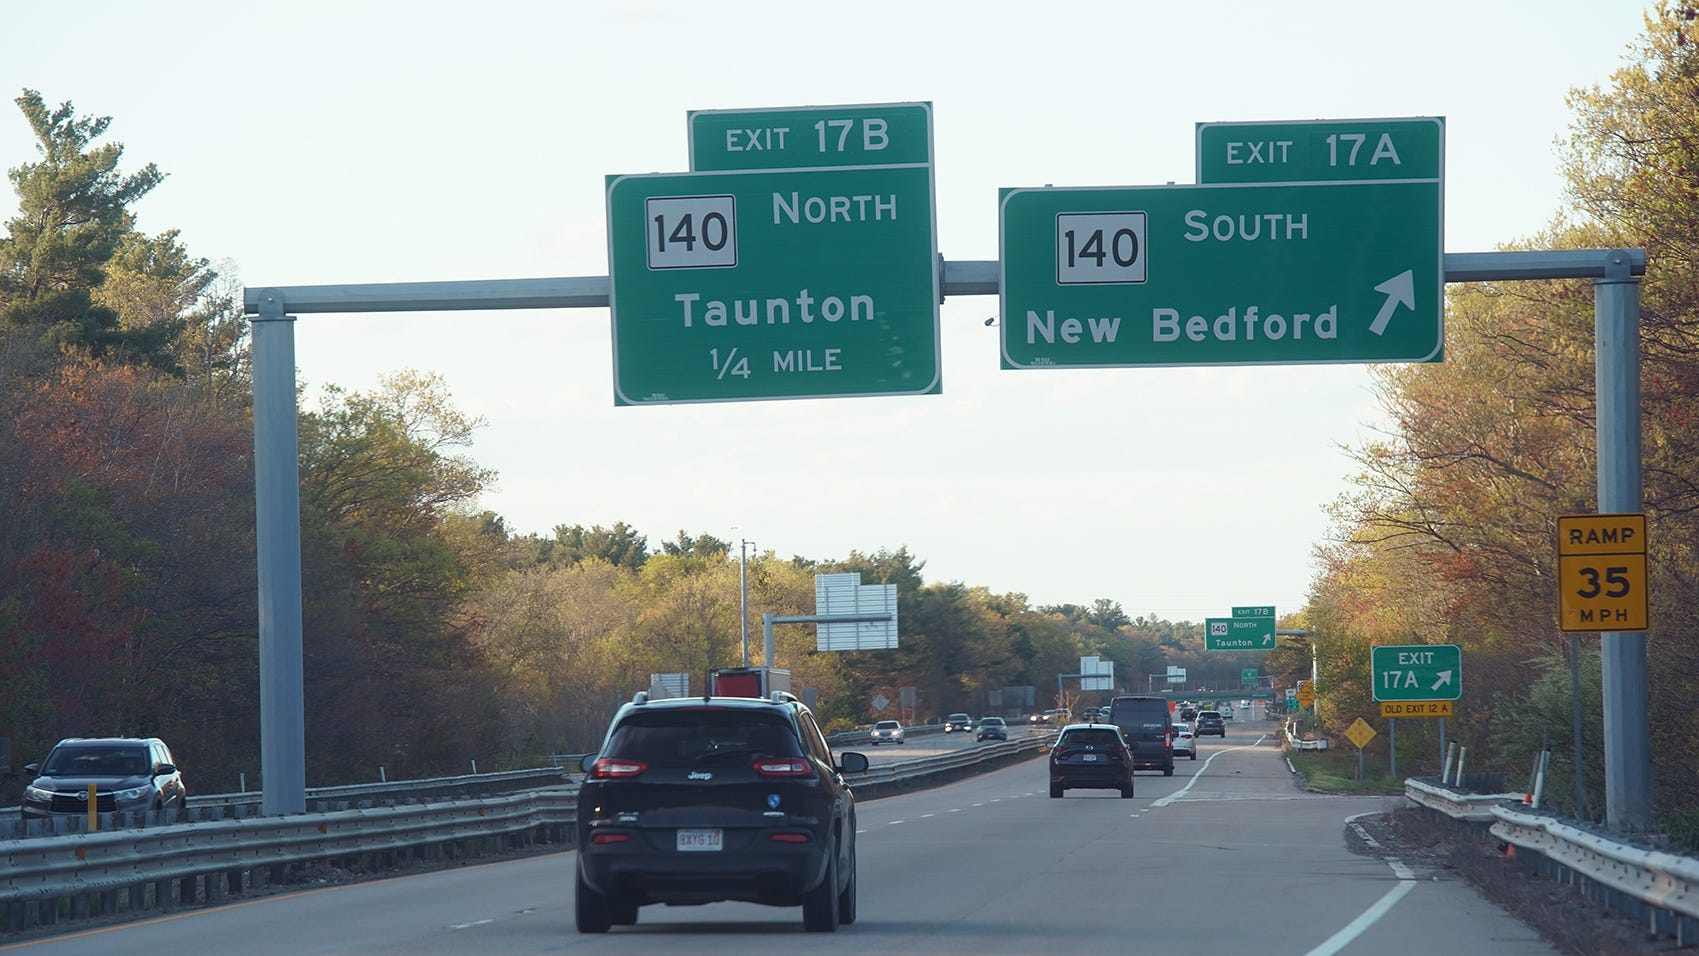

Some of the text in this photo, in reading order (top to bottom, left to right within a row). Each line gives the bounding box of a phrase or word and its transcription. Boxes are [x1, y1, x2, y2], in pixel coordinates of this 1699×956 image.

[726, 118, 890, 153] EXIT 17B
[1226, 133, 1402, 167] EXIT 17A
[772, 191, 898, 224] NORTH
[653, 211, 729, 253] 140
[1183, 209, 1309, 242] SOUTH
[1064, 227, 1139, 268] 140
[674, 288, 875, 327] Taunton
[1026, 304, 1337, 345] New Bedford
[772, 348, 843, 373] MILE
[1569, 527, 1635, 545] RAMP
[1576, 566, 1631, 599] 35
[1233, 621, 1257, 629] NORTH
[1579, 608, 1628, 623] MPH
[1211, 624, 1227, 633] 140
[1215, 639, 1253, 647] Taunton
[1398, 651, 1435, 665] EXIT
[1382, 670, 1419, 689] 17A
[1384, 704, 1449, 714] OLD EXIT 12 A
[687, 771, 713, 781] Jeep
